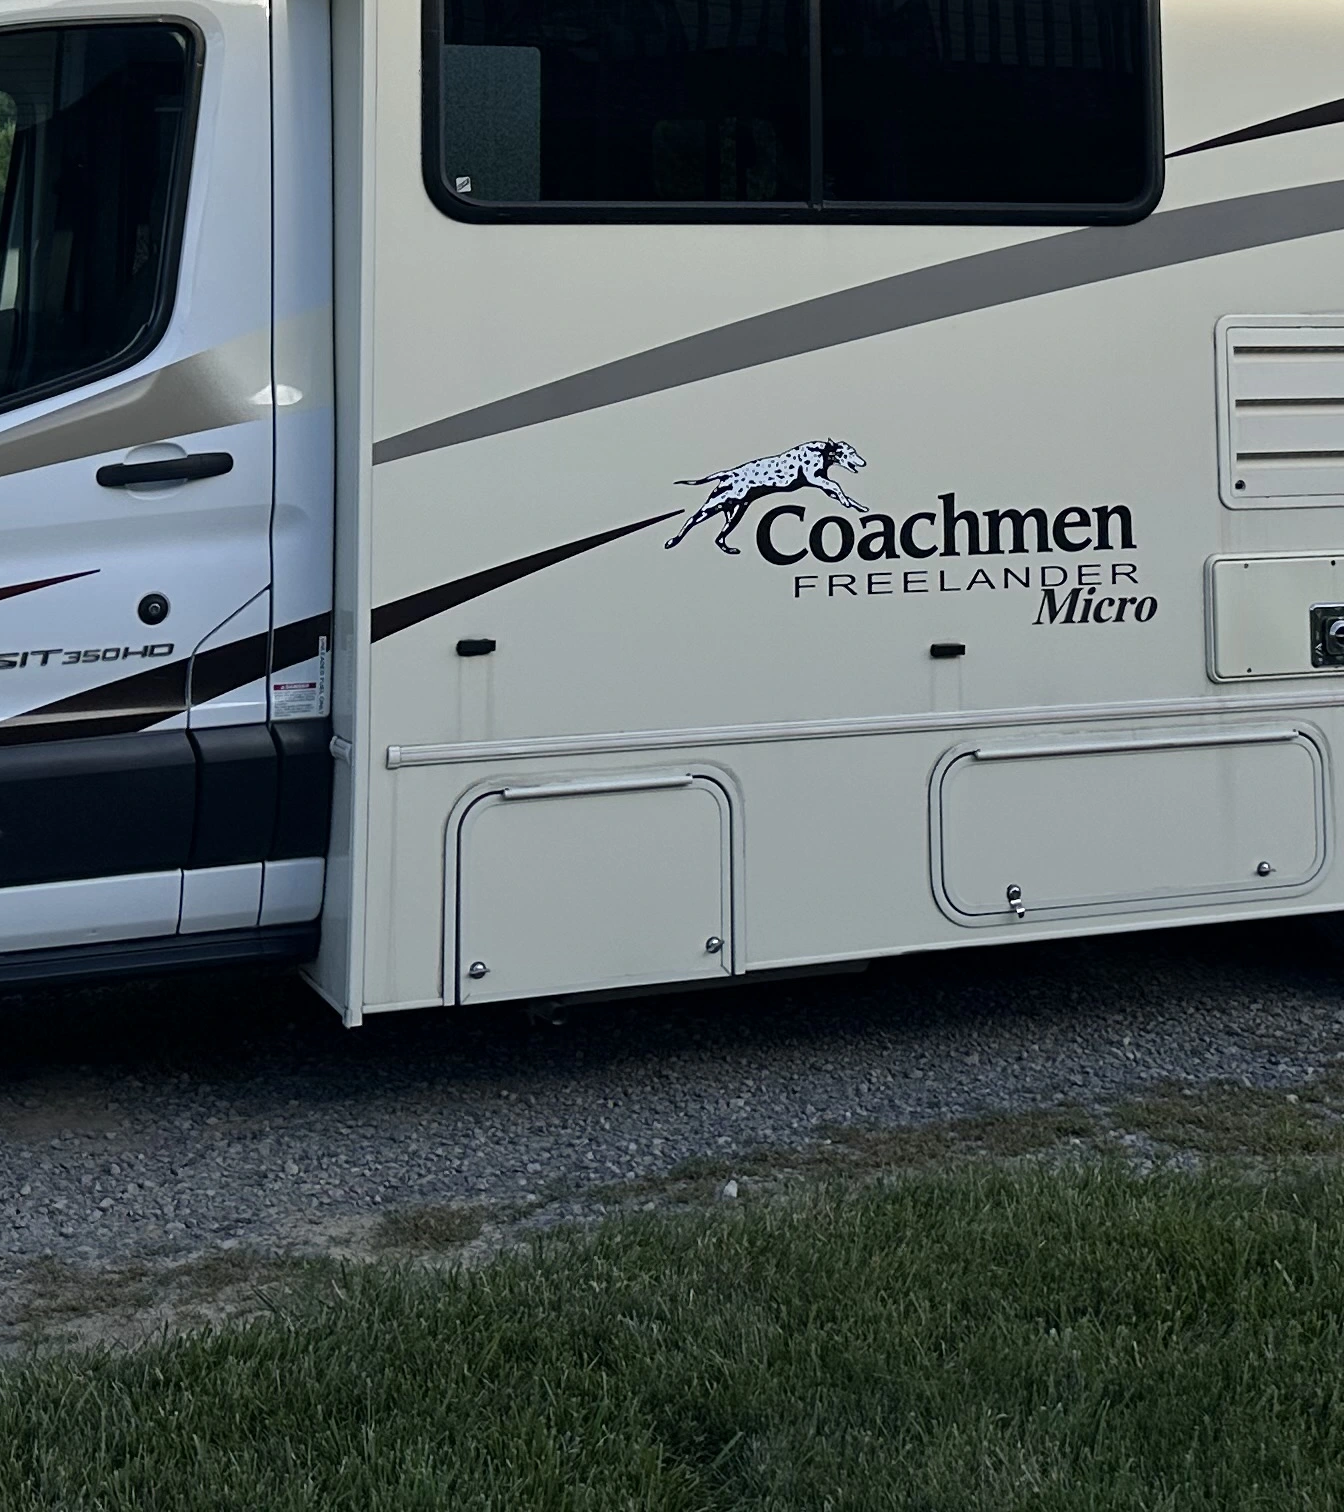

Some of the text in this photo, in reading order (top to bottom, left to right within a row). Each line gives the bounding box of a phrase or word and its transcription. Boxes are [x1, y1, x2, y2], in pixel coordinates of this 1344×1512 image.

[756, 492, 1137, 565] Coachmen
[794, 563, 1139, 598] FREELANDER
[1032, 586, 1157, 625] Micro
